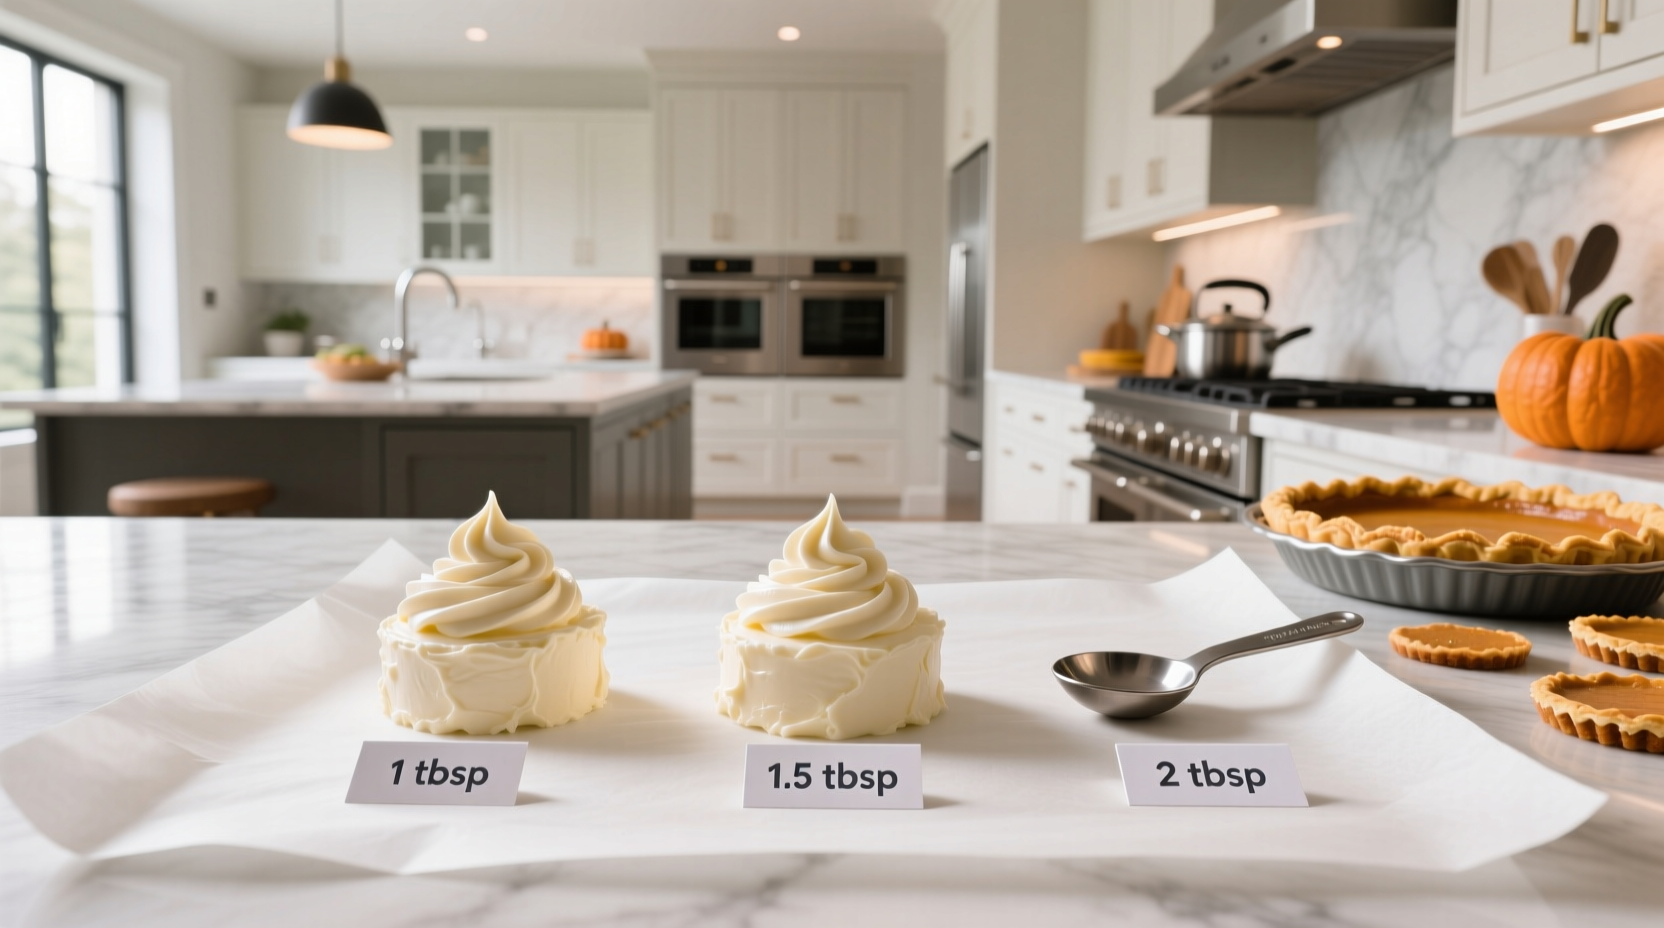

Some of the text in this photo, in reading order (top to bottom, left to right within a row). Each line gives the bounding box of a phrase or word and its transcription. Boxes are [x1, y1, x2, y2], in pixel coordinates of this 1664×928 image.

[391, 757, 489, 793] 1 tbsp
[768, 761, 898, 797] 1.5 tbsp
[1156, 759, 1267, 794] 2 tbsp
